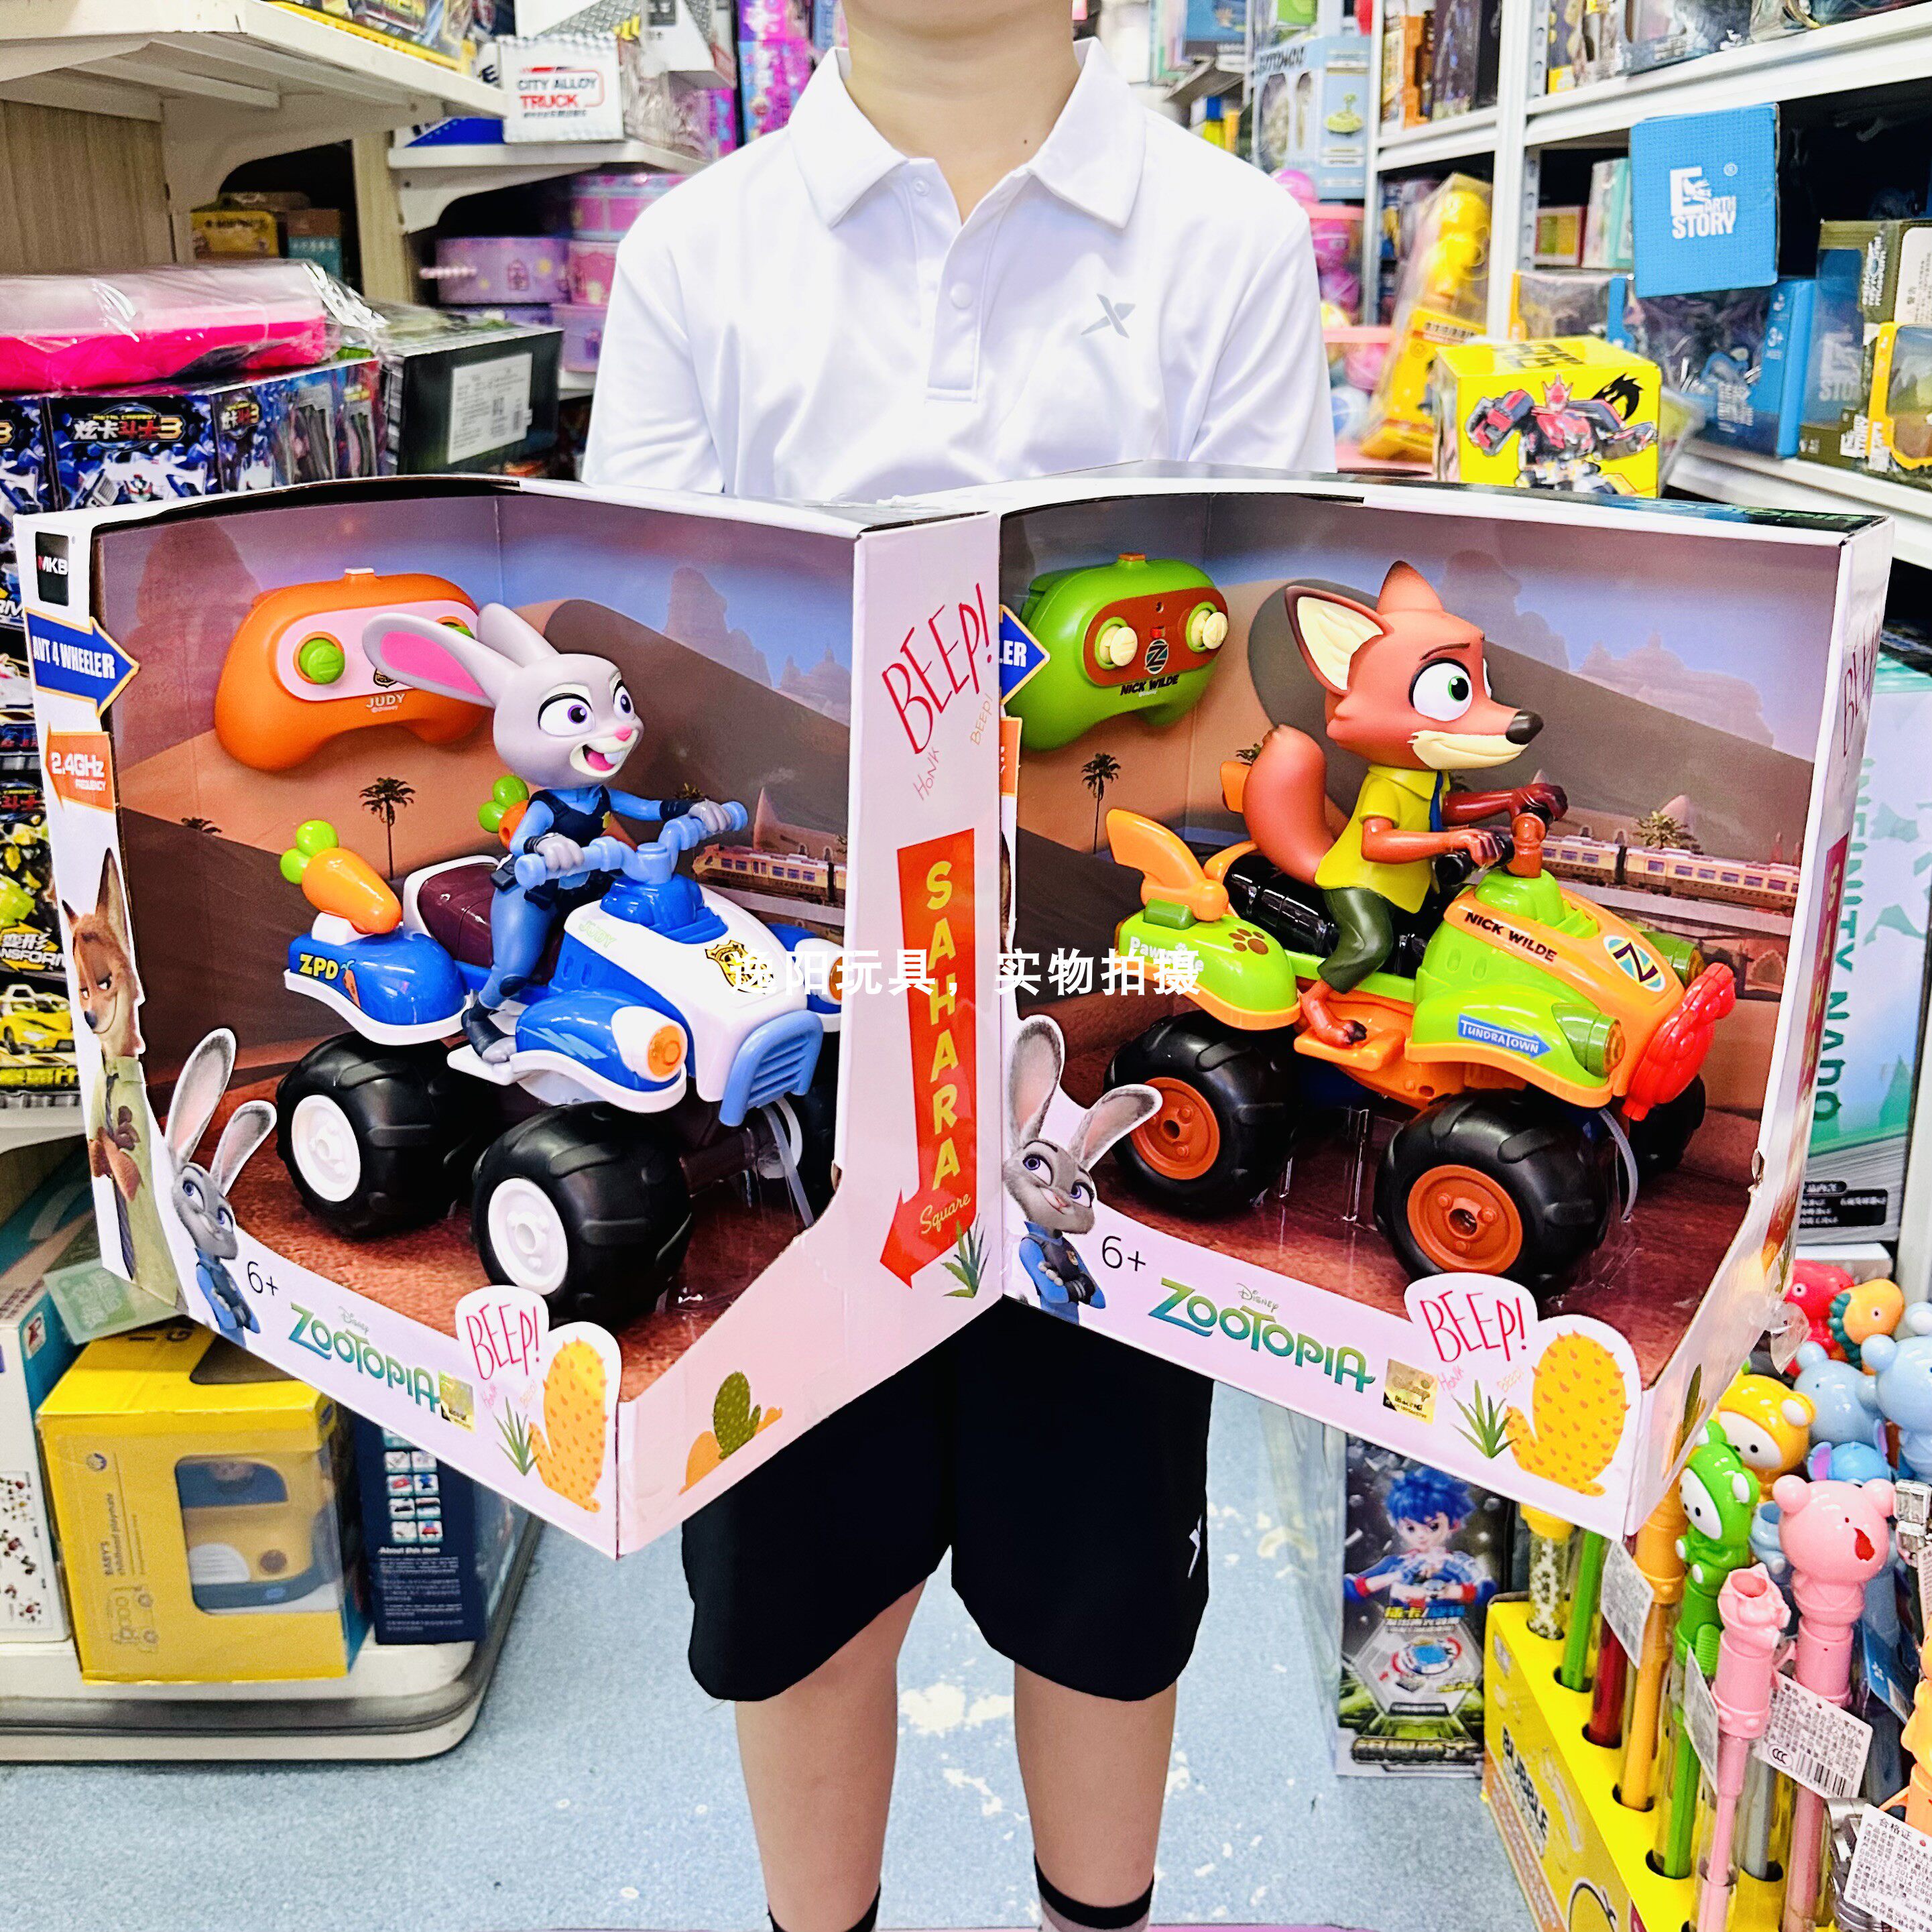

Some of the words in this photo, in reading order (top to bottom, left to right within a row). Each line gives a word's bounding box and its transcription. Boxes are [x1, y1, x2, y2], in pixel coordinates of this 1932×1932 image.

[517, 77, 547, 91] CITY
[555, 75, 597, 88] ALLOY
[520, 95, 578, 109] TRUCK
[1671, 210, 1737, 239] STORY
[38, 555, 68, 575] MKB
[52, 641, 60, 666] 4
[59, 642, 116, 679] WHEELER
[882, 582, 992, 755] BEEP!
[365, 693, 406, 708] JUDY
[1120, 680, 1147, 696] NICK
[1149, 674, 1180, 690] WILDE
[51, 751, 105, 778] 2.4GHz
[1463, 912, 1501, 935] NICK
[1508, 929, 1558, 963] WILDE
[299, 953, 339, 980] ZPD
[925, 860, 962, 1192] SAHARA
[1813, 990, 1850, 1122] NADO
[919, 1191, 972, 1235] Square
[1101, 1235, 1146, 1272] 6+
[247, 1260, 280, 1296] 6+
[466, 1303, 540, 1380] BEEP!
[1148, 1277, 1376, 1394] ZOOTOPIA
[1419, 1290, 1527, 1363] BEEP!
[288, 1302, 440, 1414] ZOOTOPIA
[1878, 1817, 1913, 1842] 合格证
